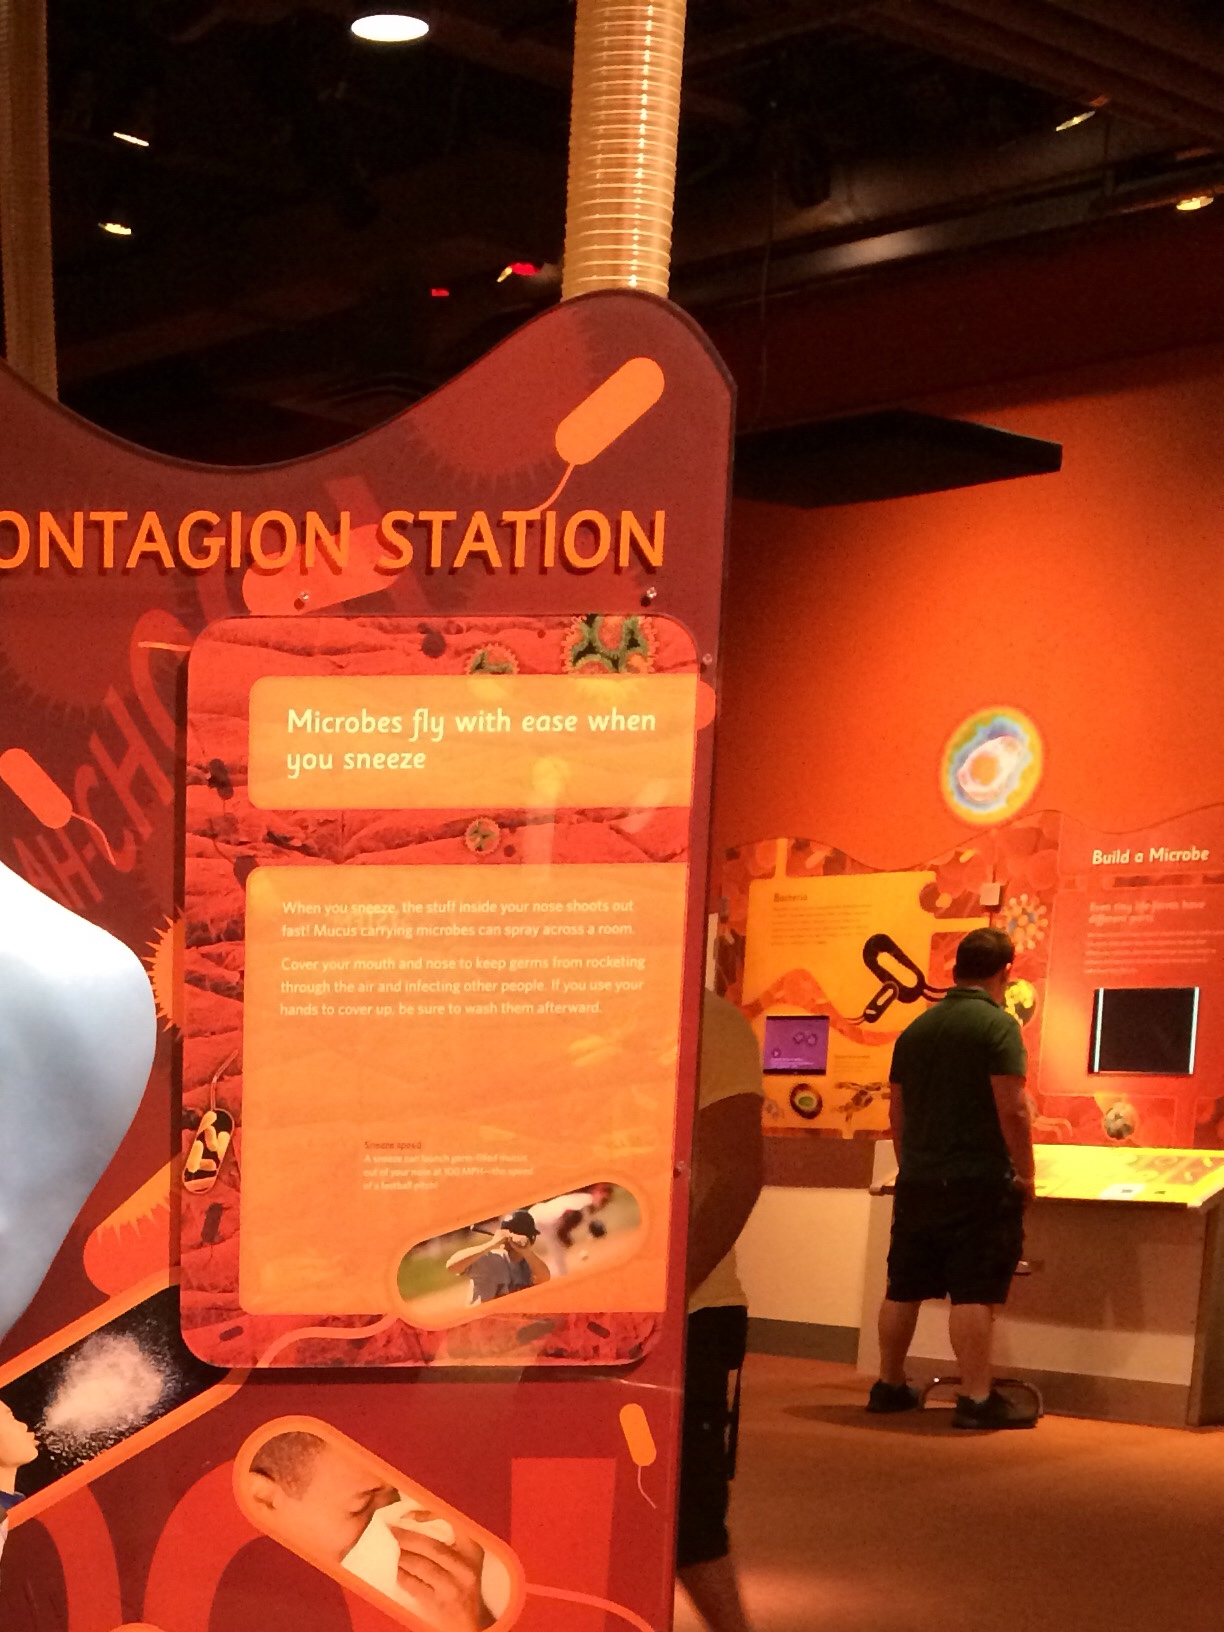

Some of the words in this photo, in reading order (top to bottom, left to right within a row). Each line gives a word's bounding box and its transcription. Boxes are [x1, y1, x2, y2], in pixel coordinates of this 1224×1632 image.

[379, 509, 666, 569] STATION
[287, 709, 403, 734] Microbes
[409, 708, 445, 741] fly
[456, 708, 511, 733] with
[522, 714, 577, 732] ease
[589, 708, 656, 731] when
[286, 752, 334, 779] you
[344, 751, 426, 771] sneeze
[1092, 849, 1130, 864] Build
[1135, 852, 1144, 863] a
[1149, 845, 1209, 862] Microbe
[282, 902, 321, 914] When
[324, 903, 347, 917] you
[351, 903, 398, 915] sneeze,
[402, 901, 423, 913] the
[427, 901, 456, 913] stuff
[459, 901, 497, 913] inside
[500, 902, 529, 915] your
[532, 902, 563, 912] nose
[566, 900, 609, 912] shoots
[612, 900, 634, 911] out
[282, 924, 310, 937] fast!
[313, 925, 357, 937] Mucus
[360, 925, 413, 939] carrying
[416, 924, 475, 936] microbes
[478, 926, 501, 935] can
[504, 925, 539, 937] spray
[543, 925, 584, 935] across
[587, 926, 595, 934] a
[598, 925, 635, 935] room.
[281, 958, 319, 970] Cover
[322, 959, 350, 972] your
[353, 957, 395, 970] mouth
[398, 957, 422, 969] and
[427, 959, 456, 969] nose
[459, 958, 472, 969] to
[476, 957, 506, 971] keep
[509, 958, 549, 971] germs
[552, 956, 582, 969] from
[586, 956, 646, 970] rocketing
[280, 981, 330, 995] through
[334, 980, 354, 992] the
[357, 981, 374, 992] air
[377, 980, 401, 992] and
[405, 979, 460, 994] infecting
[463, 979, 498, 992] other
[551, 978, 561, 990] If
[563, 980, 586, 993] you
[590, 980, 611, 990] use
[614, 980, 644, 993] your
[280, 1003, 318, 1015] hands
[321, 1004, 335, 1015] to
[338, 1005, 372, 1015] cover
[399, 1002, 415, 1015] be
[418, 1004, 445, 1015] sure
[448, 1003, 462, 1015] to
[465, 1002, 498, 1014] wash
[501, 1001, 534, 1014] them
[536, 1001, 601, 1014] afterward.
